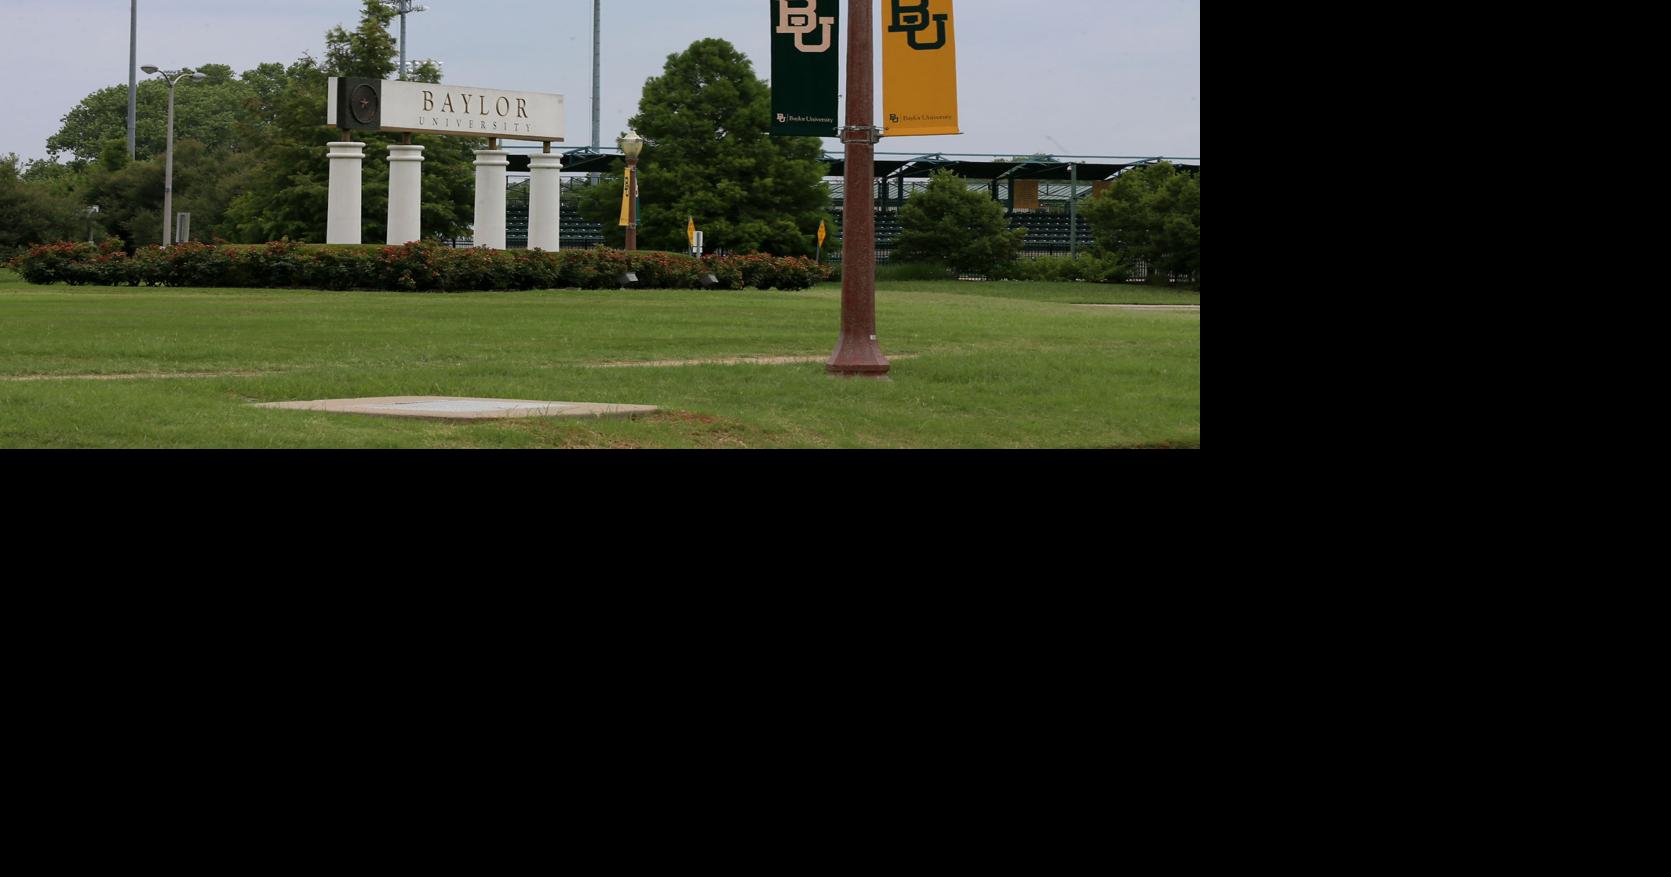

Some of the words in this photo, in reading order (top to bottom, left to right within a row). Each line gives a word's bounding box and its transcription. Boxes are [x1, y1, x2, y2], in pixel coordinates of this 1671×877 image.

[776, 0, 835, 53] BU
[888, 0, 948, 50] BU
[421, 90, 529, 118] BAYLOR
[419, 116, 531, 132] UNIVERSITY
[806, 115, 833, 123] University
